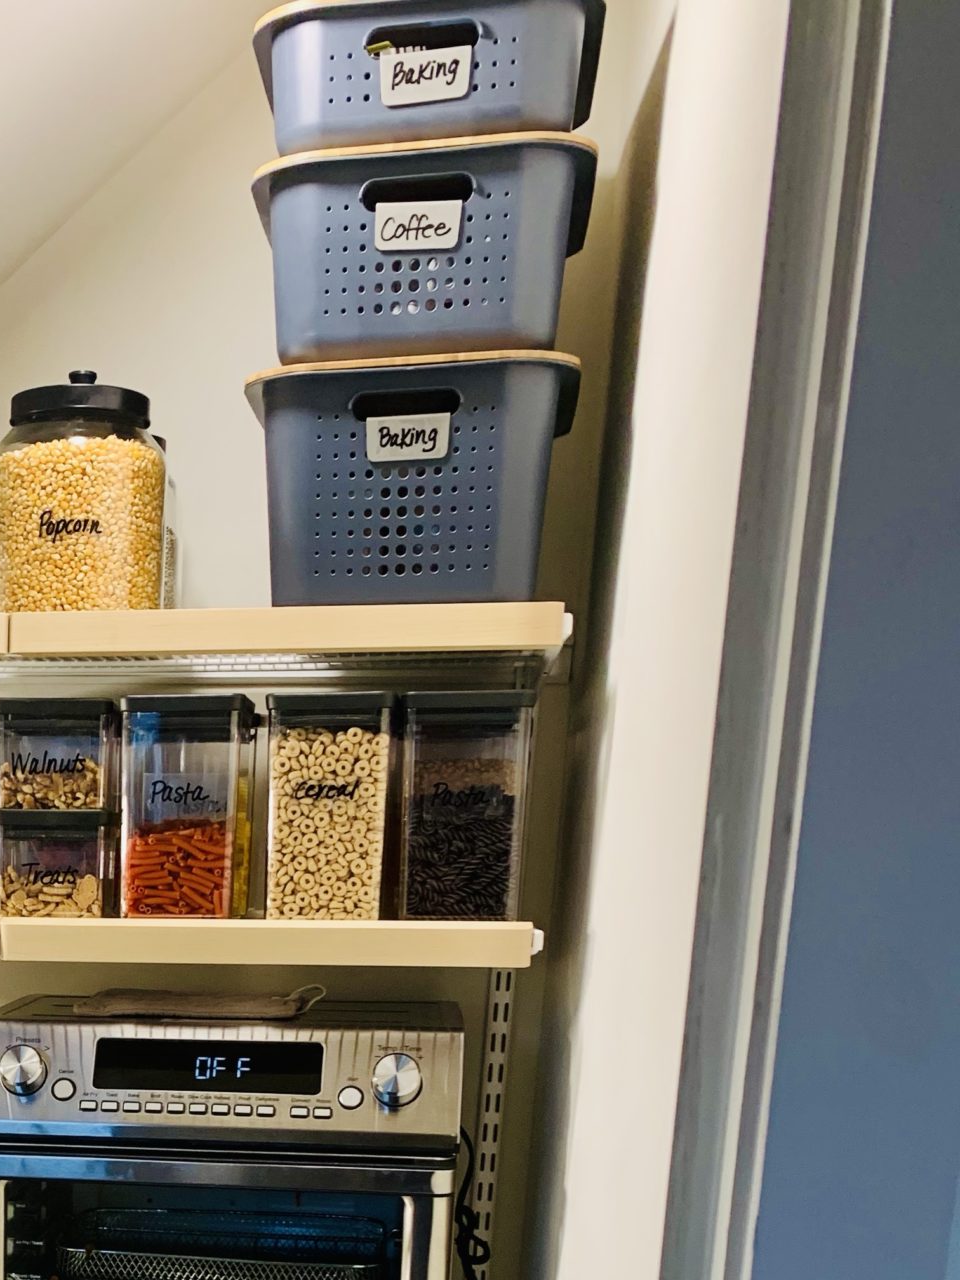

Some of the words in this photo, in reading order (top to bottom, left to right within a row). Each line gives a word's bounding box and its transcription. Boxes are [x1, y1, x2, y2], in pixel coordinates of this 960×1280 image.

[392, 58, 459, 91] Baking
[380, 216, 452, 243] Coffee
[378, 424, 439, 454] Baking
[38, 510, 103, 544] Popcorn
[11, 750, 87, 776] Walnuts
[150, 780, 210, 804] Pasta
[22, 863, 79, 886] Treats
